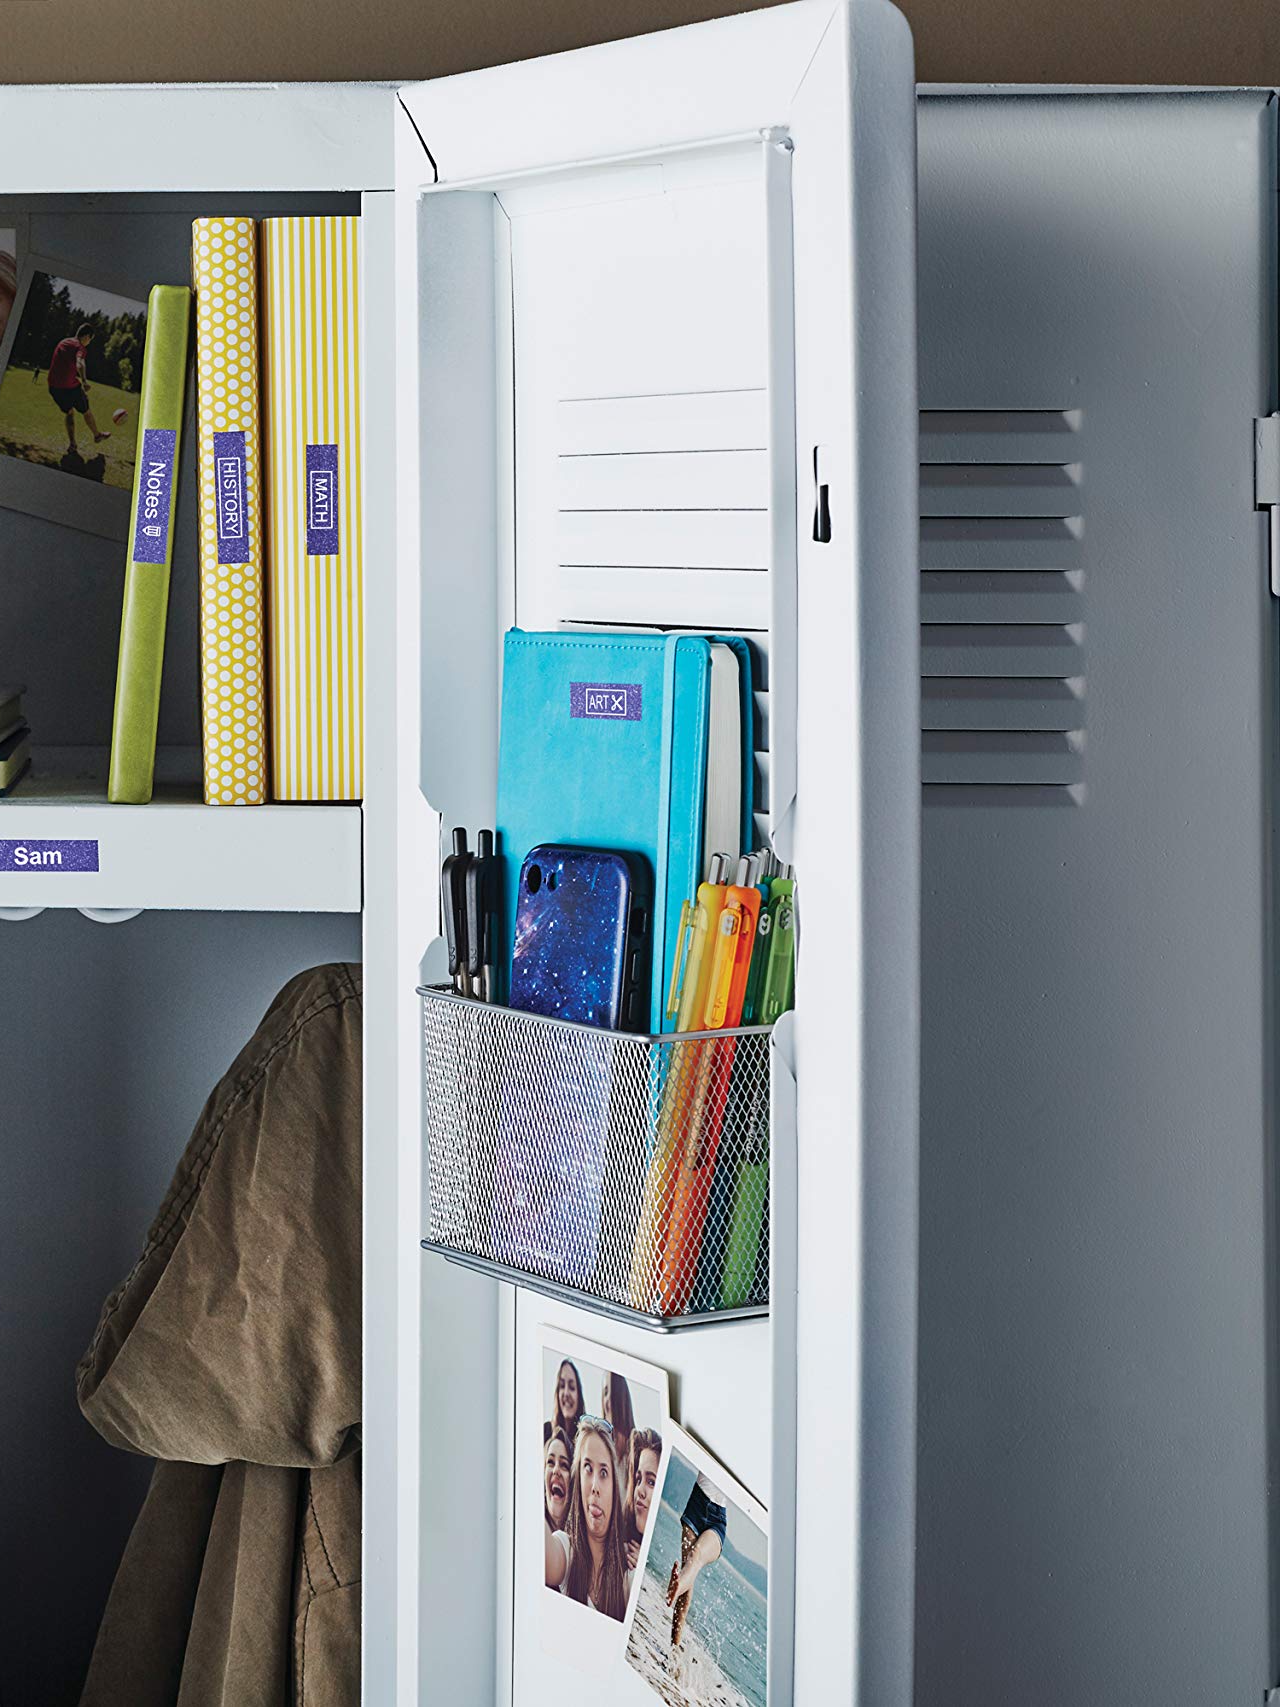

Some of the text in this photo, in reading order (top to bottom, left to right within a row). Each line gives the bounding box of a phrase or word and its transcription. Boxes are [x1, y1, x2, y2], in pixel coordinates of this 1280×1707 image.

[144, 461, 167, 519] Notes
[223, 462, 240, 534] HISTORY
[315, 478, 328, 523] MATH
[588, 694, 609, 710] ART
[14, 846, 62, 866] Sam
